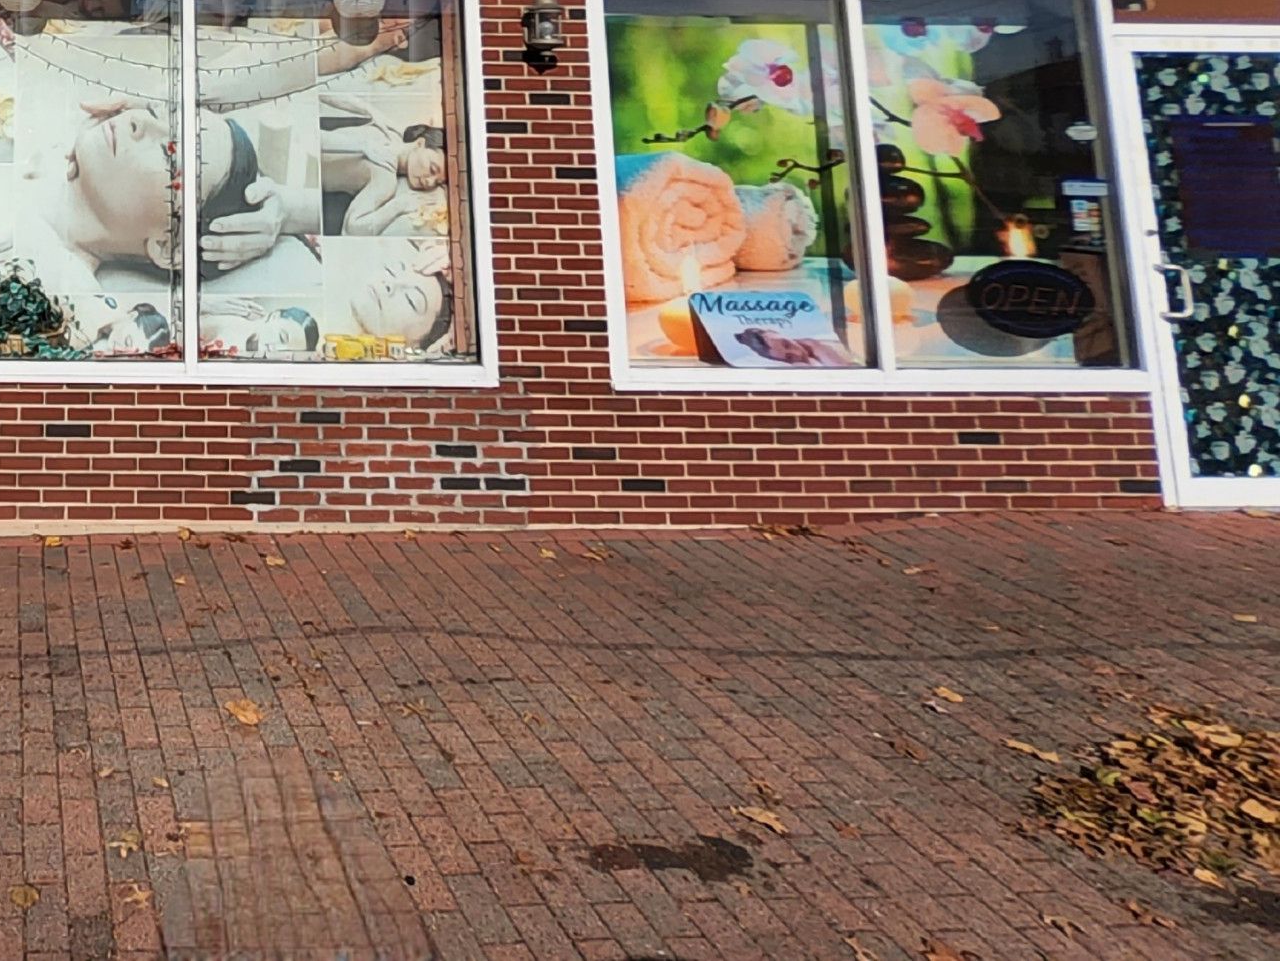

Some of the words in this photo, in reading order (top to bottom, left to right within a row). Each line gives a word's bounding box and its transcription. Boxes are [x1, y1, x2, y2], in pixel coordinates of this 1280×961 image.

[688, 292, 815, 318] Massage
[981, 281, 1081, 318] OPEN
[733, 314, 792, 328] Therapy
